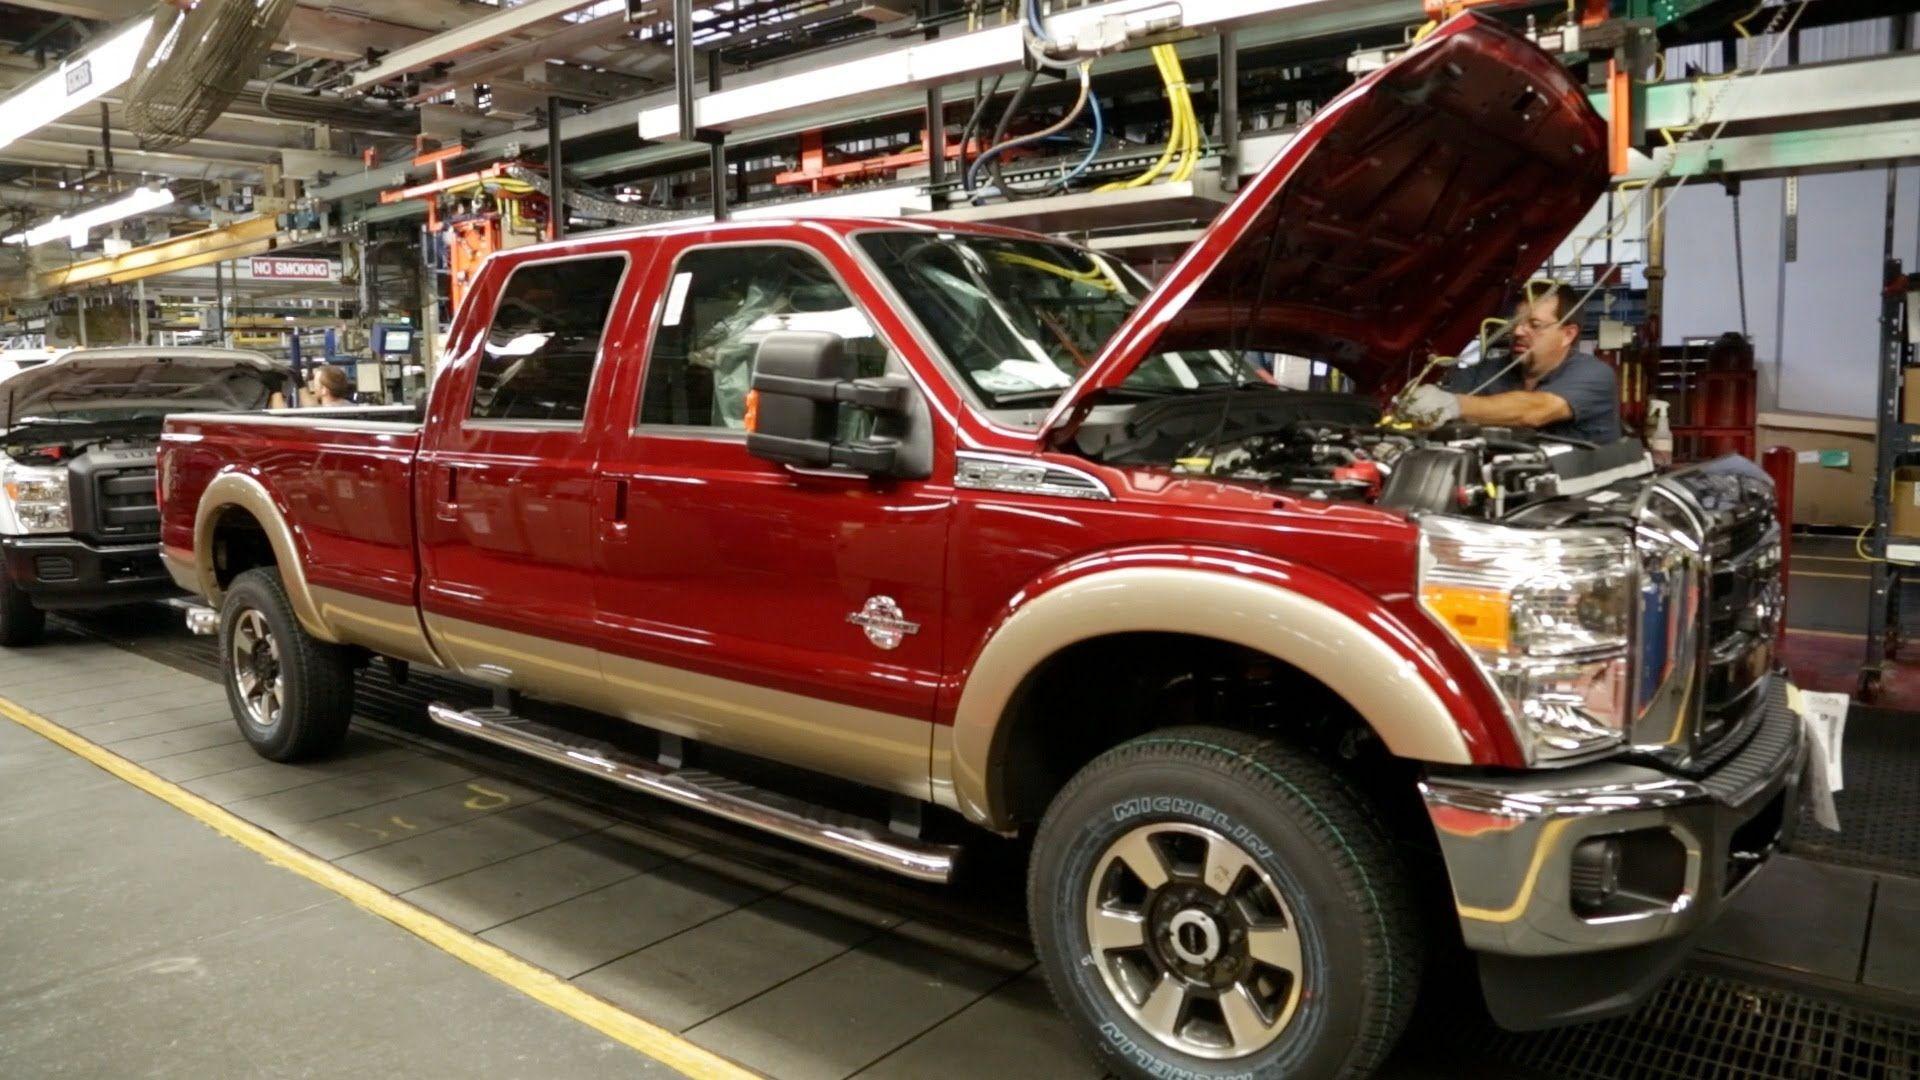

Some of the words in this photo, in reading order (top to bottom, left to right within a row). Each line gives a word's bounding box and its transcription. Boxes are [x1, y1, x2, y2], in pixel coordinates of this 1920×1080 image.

[254, 261, 272, 275] NO
[275, 262, 328, 276] SMOKING
[1113, 796, 1274, 859] MICHELIN
